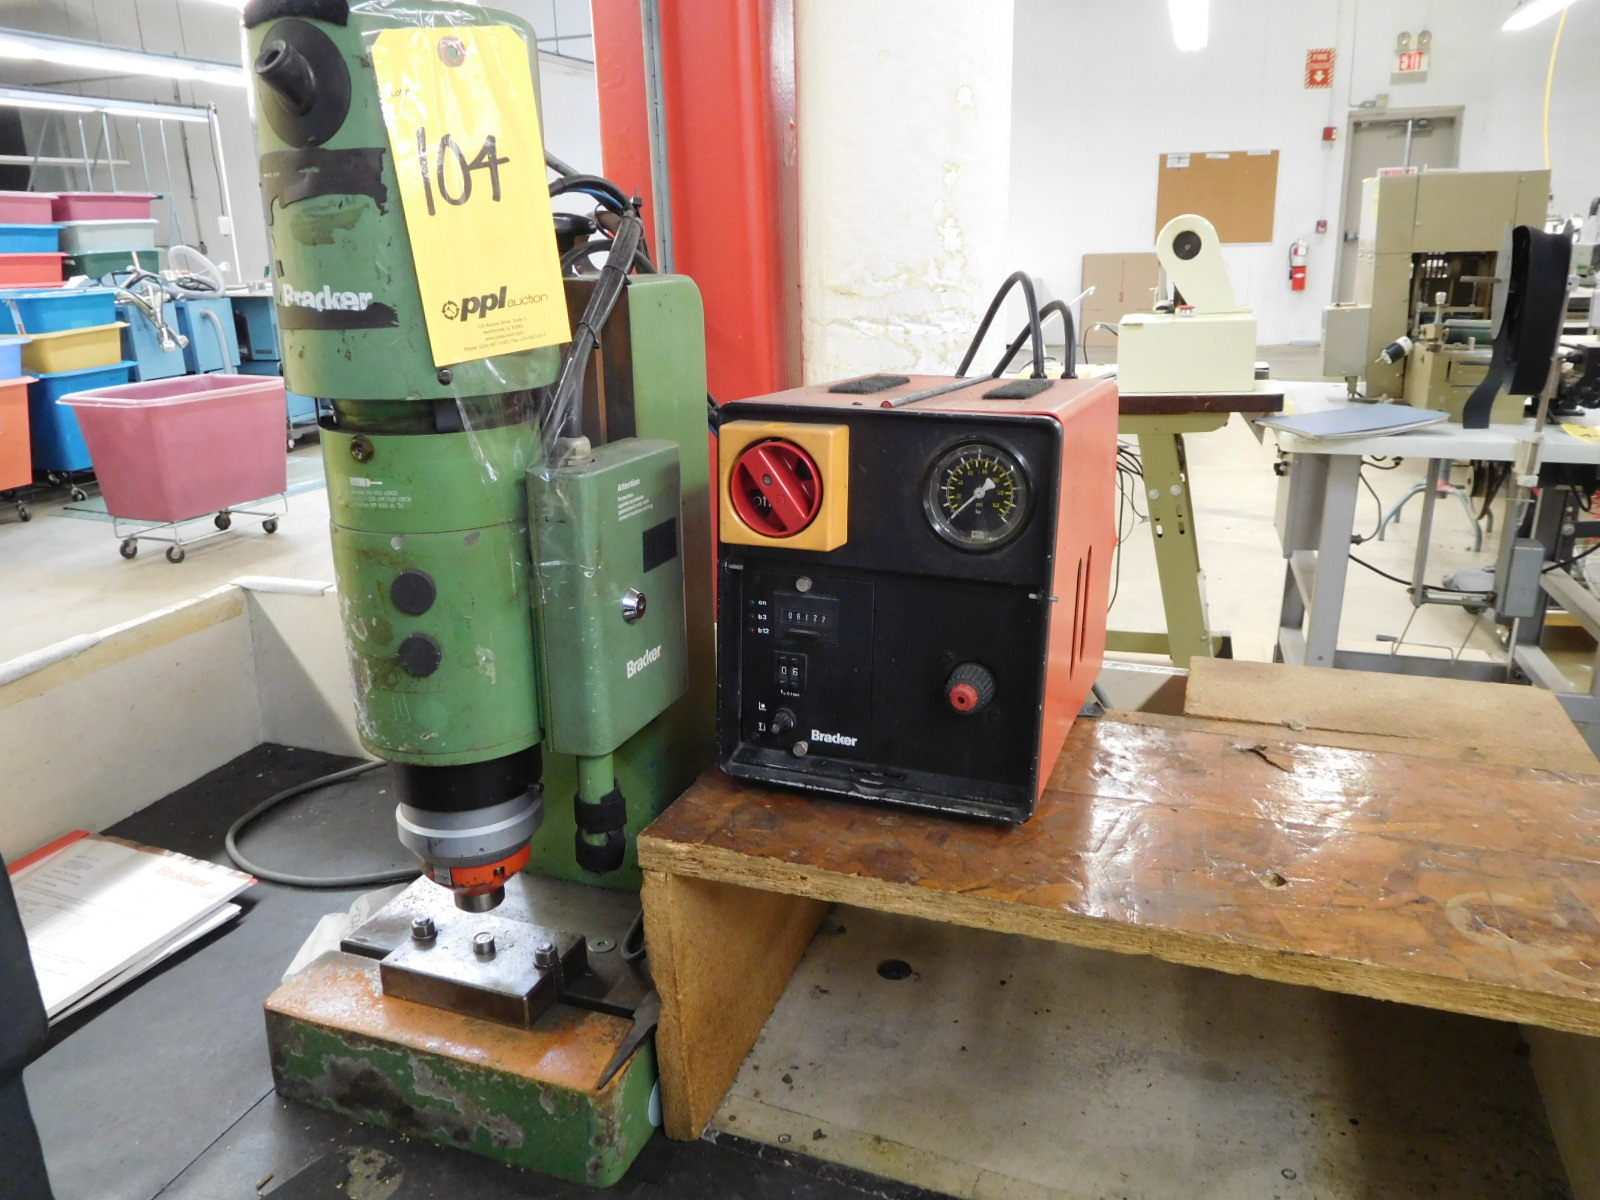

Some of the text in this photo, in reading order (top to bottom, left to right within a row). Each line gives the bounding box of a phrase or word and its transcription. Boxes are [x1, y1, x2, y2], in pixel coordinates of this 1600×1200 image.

[1399, 52, 1424, 71] EXIT
[416, 127, 510, 216] 104
[282, 284, 373, 312] Bracker
[460, 286, 549, 322] ppl auction
[617, 479, 640, 492] Attention
[757, 613, 767, 621] b3
[626, 644, 662, 679] Bracker
[811, 729, 858, 747] Bracker
